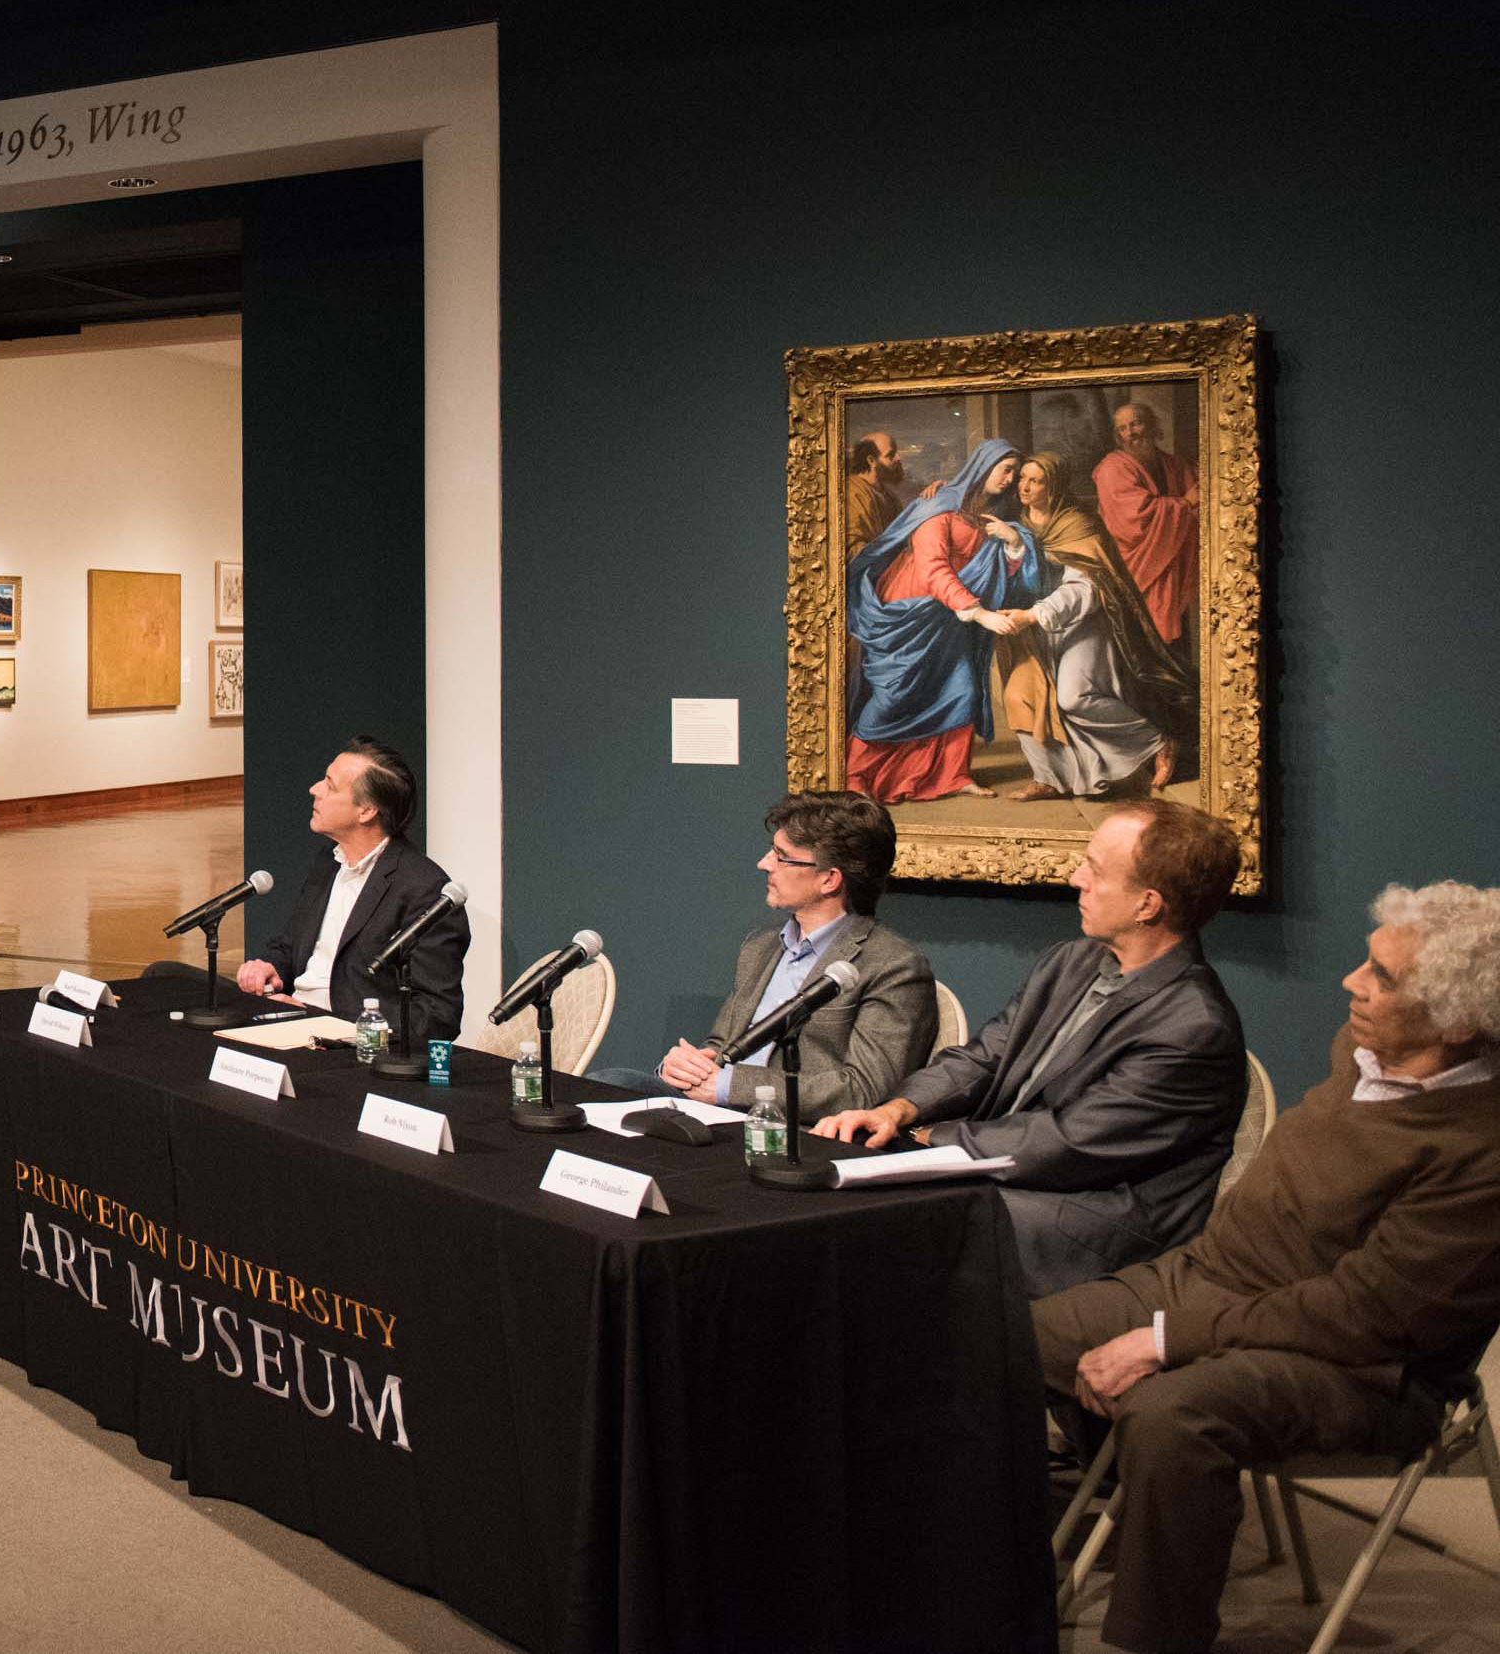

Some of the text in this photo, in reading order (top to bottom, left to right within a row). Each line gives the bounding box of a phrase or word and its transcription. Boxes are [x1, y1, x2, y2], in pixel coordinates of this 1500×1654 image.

[87, 100, 187, 146] Wing
[560, 1169, 629, 1197] George Philander
[15, 1159, 397, 1349] PRINCETON UNIVERSITY
[20, 1211, 413, 1453] ART MUSEUM
